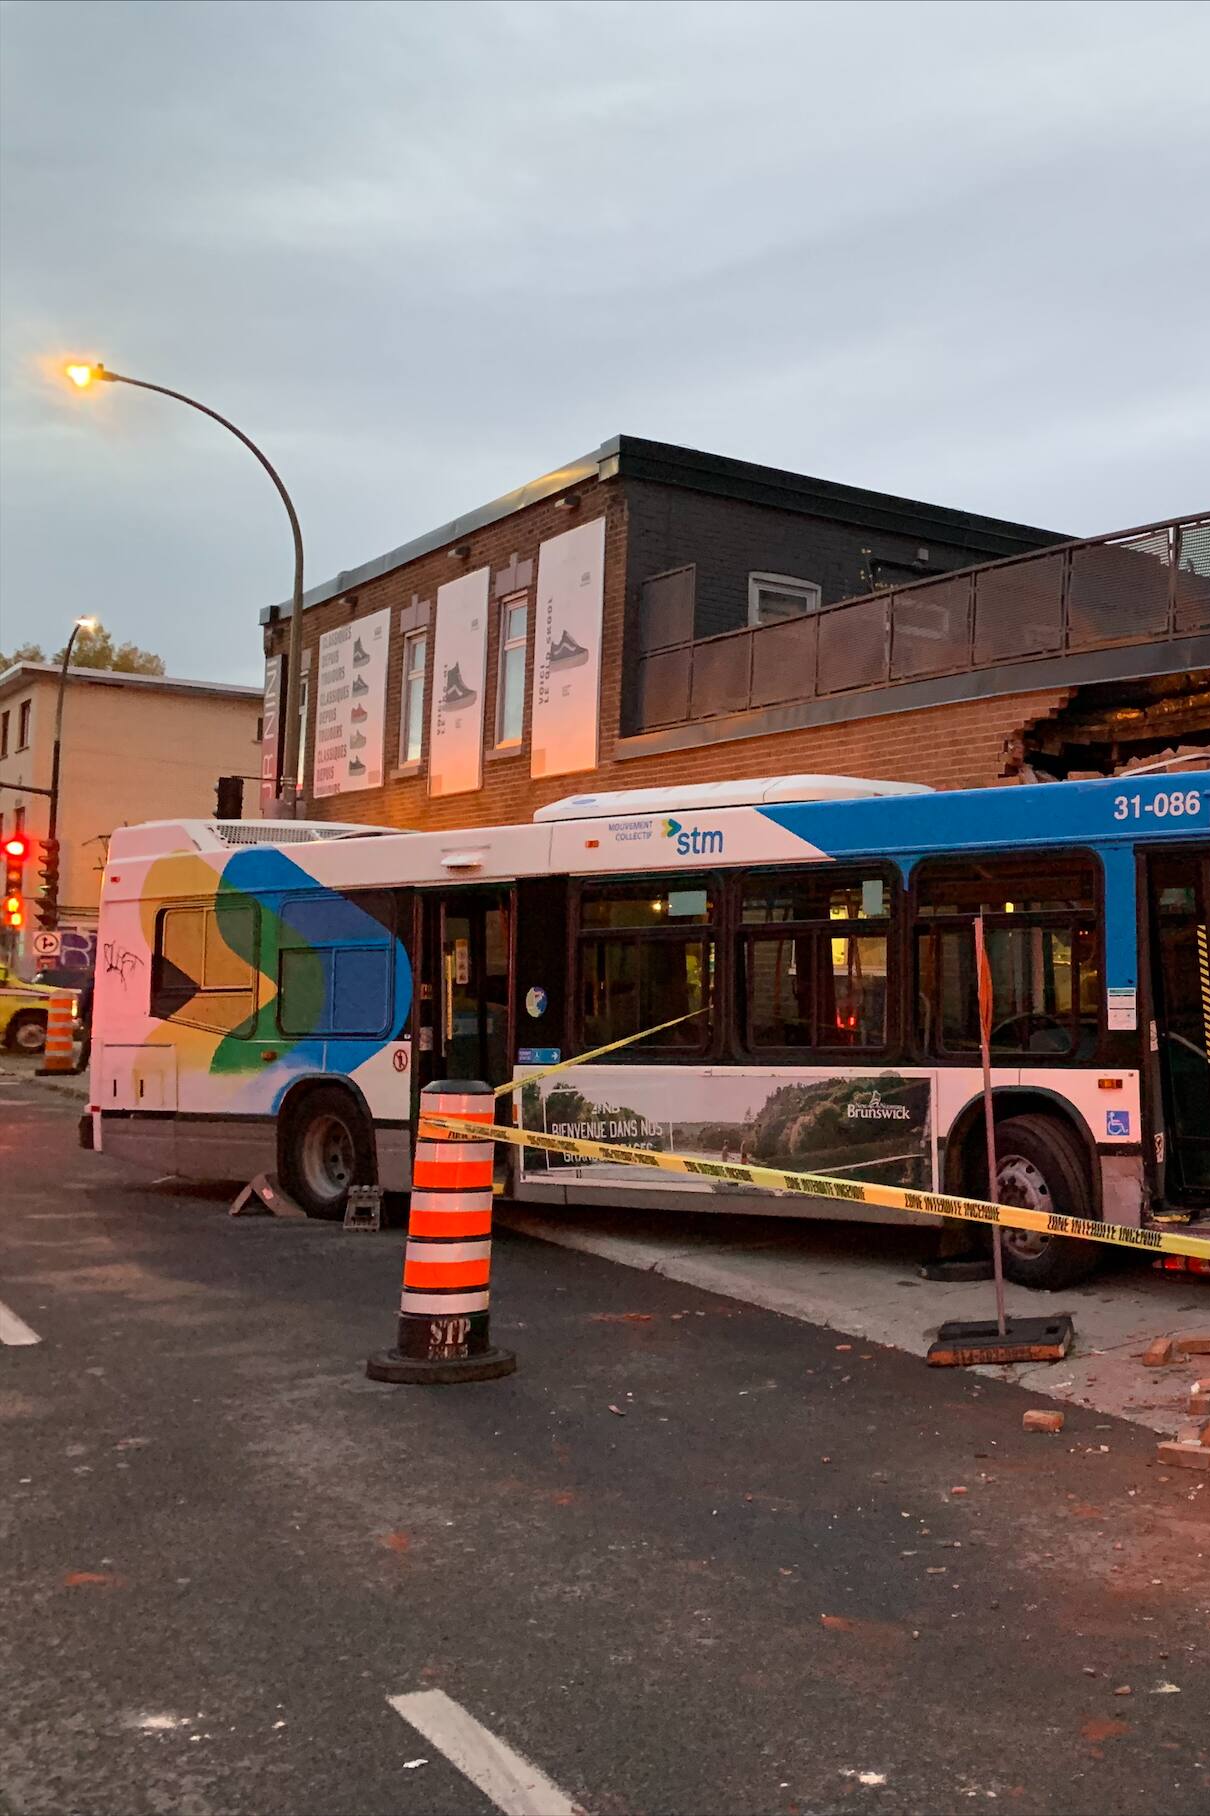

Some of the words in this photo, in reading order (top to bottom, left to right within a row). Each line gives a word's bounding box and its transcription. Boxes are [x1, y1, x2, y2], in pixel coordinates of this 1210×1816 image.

[264, 659, 278, 740] NINI
[1114, 790, 1200, 820] 31-086
[608, 820, 653, 831] MOUVEMENT
[615, 831, 652, 842] COLLECTIF
[677, 826, 723, 855] stm
[847, 1103, 910, 1120] Brunswick
[552, 1121, 607, 1139] BIENVENUE
[609, 1119, 638, 1138] DANS
[640, 1119, 663, 1137] NOS
